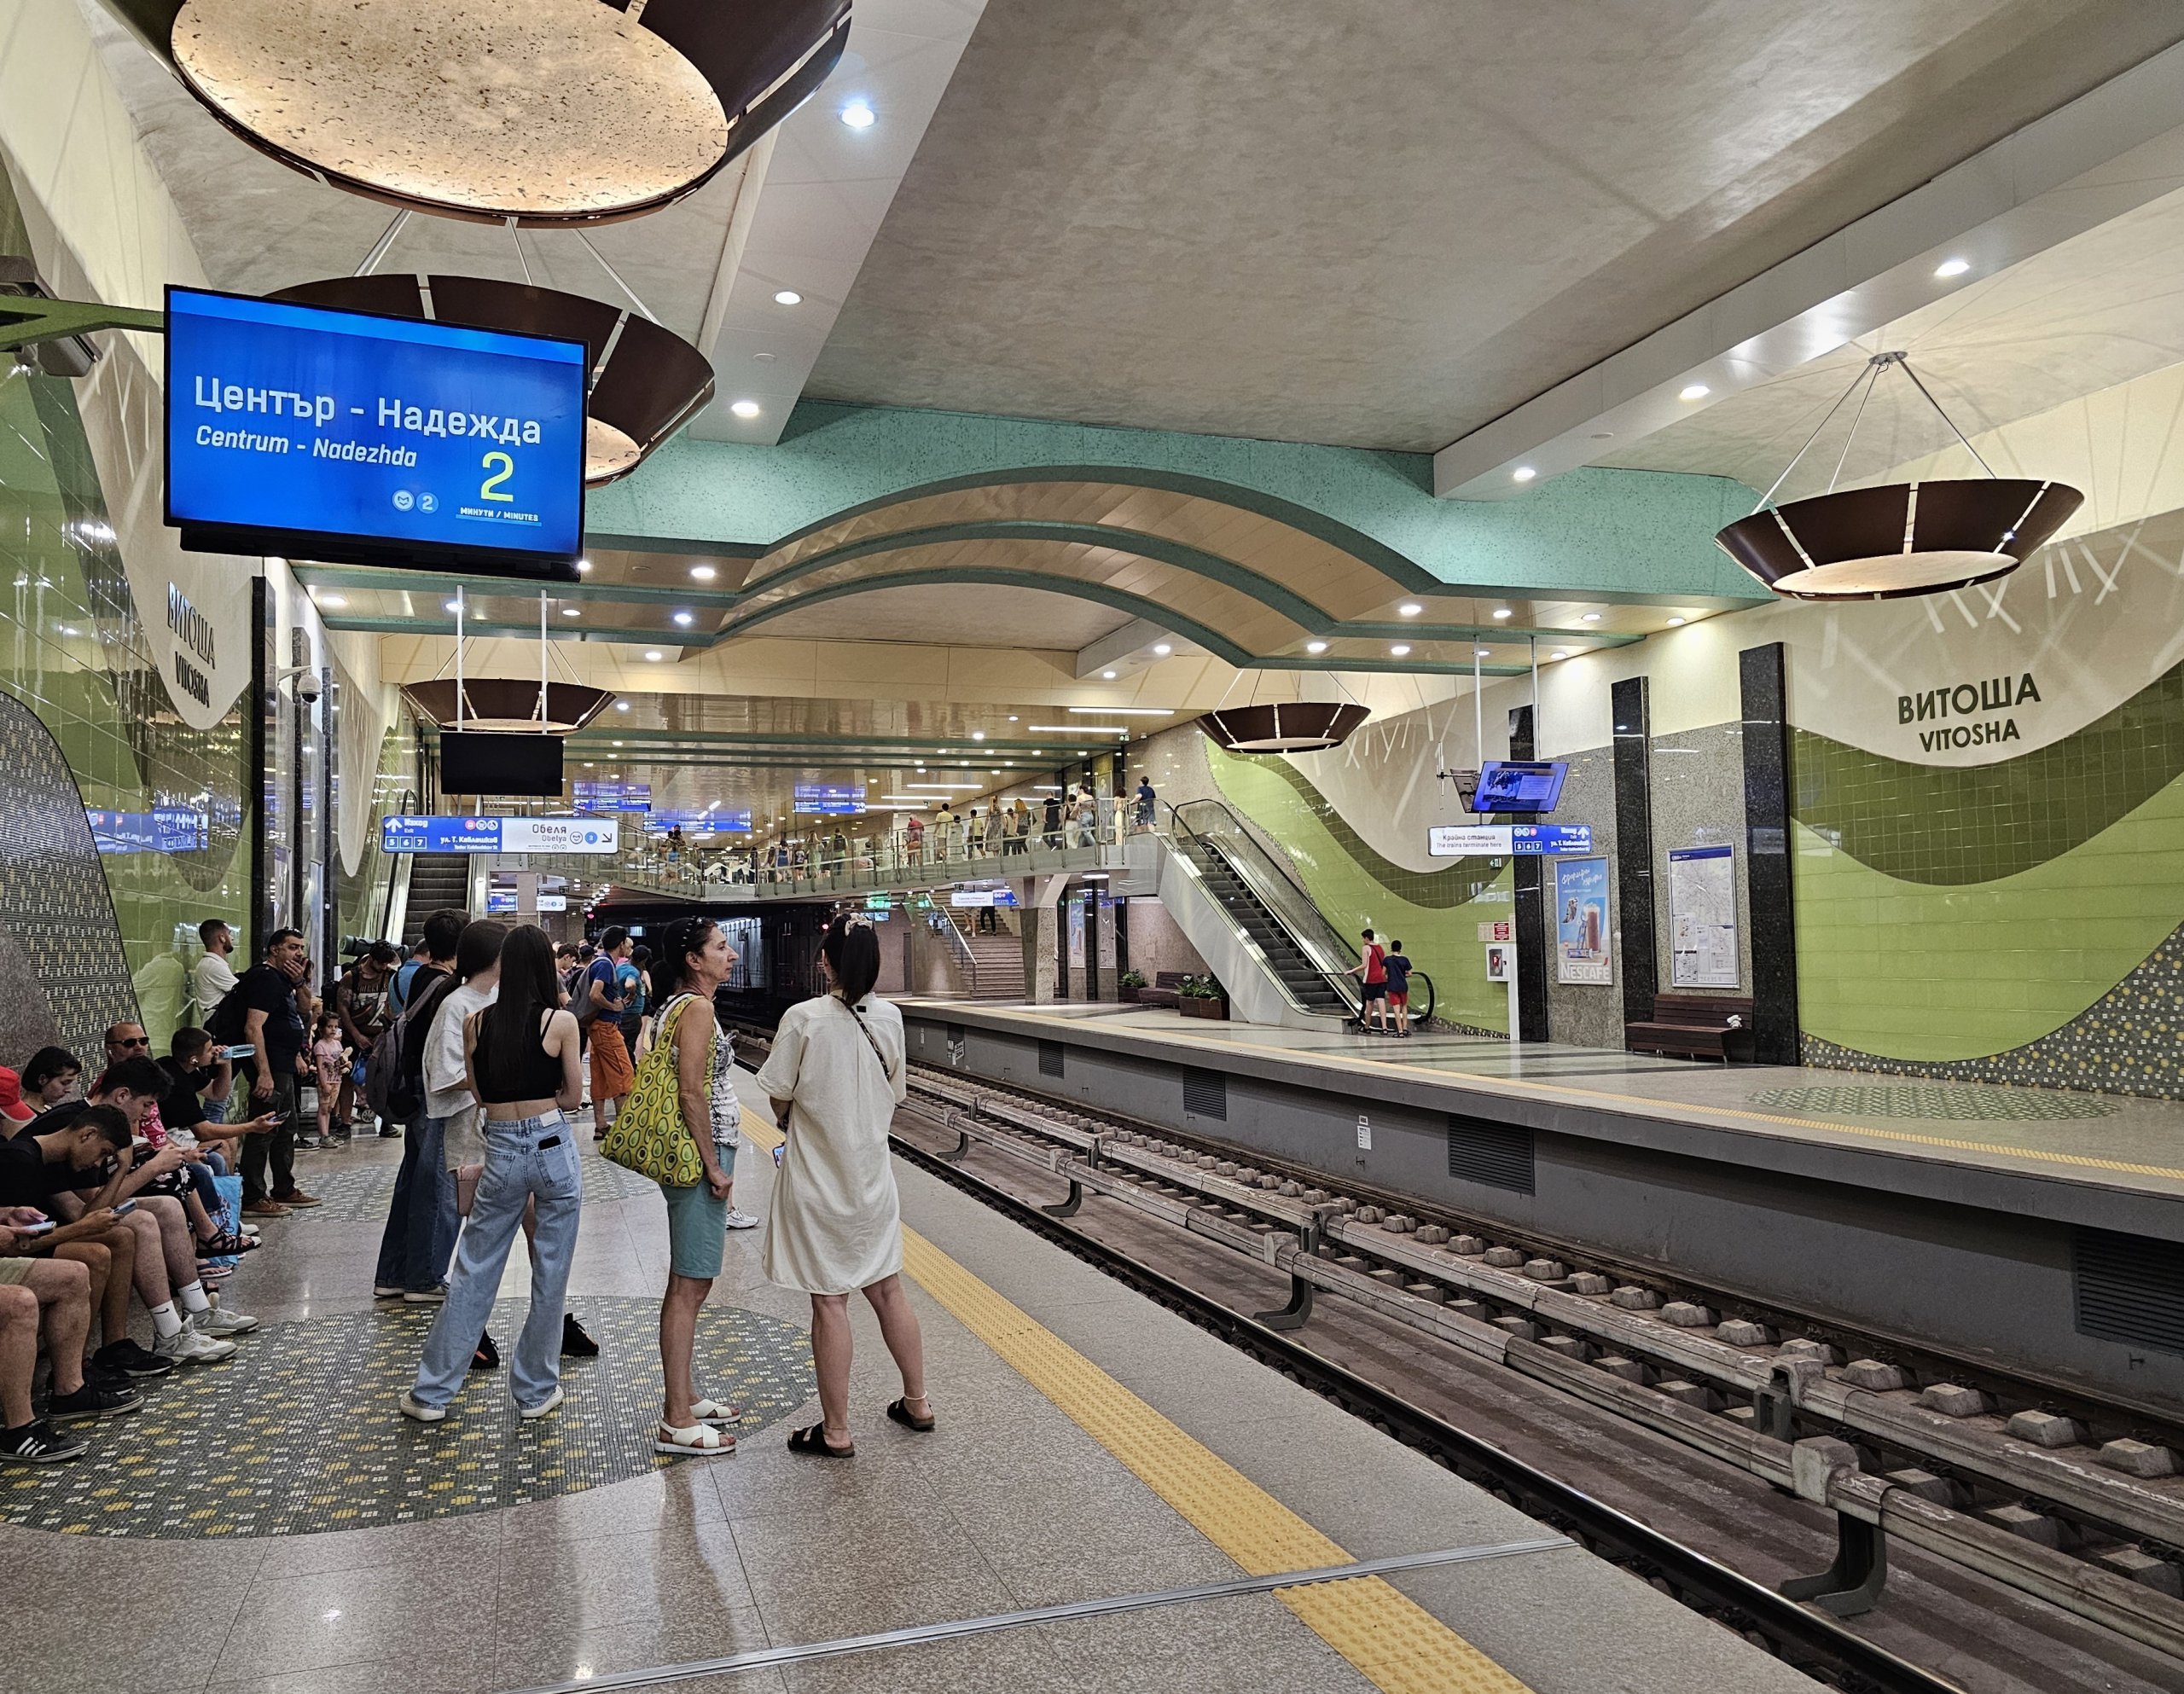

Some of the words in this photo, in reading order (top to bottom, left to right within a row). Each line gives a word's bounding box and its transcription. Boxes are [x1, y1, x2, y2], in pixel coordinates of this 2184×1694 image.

[195, 375, 335, 426] Център
[379, 397, 540, 446] Надежда
[195, 425, 289, 454] Centrum
[312, 438, 416, 467] Nadezhda
[480, 451, 514, 502] 2
[422, 496, 433, 510] 2
[460, 507, 494, 518] МИНУТИ
[503, 511, 539, 522] MINUTES
[168, 581, 216, 670] ВИТОША
[175, 651, 210, 708] VITOSHA
[1898, 673, 2042, 725] ВИТОША
[1920, 718, 2020, 752] VITOSHA
[532, 824, 567, 834] Обеля
[542, 835, 567, 844] Obelya
